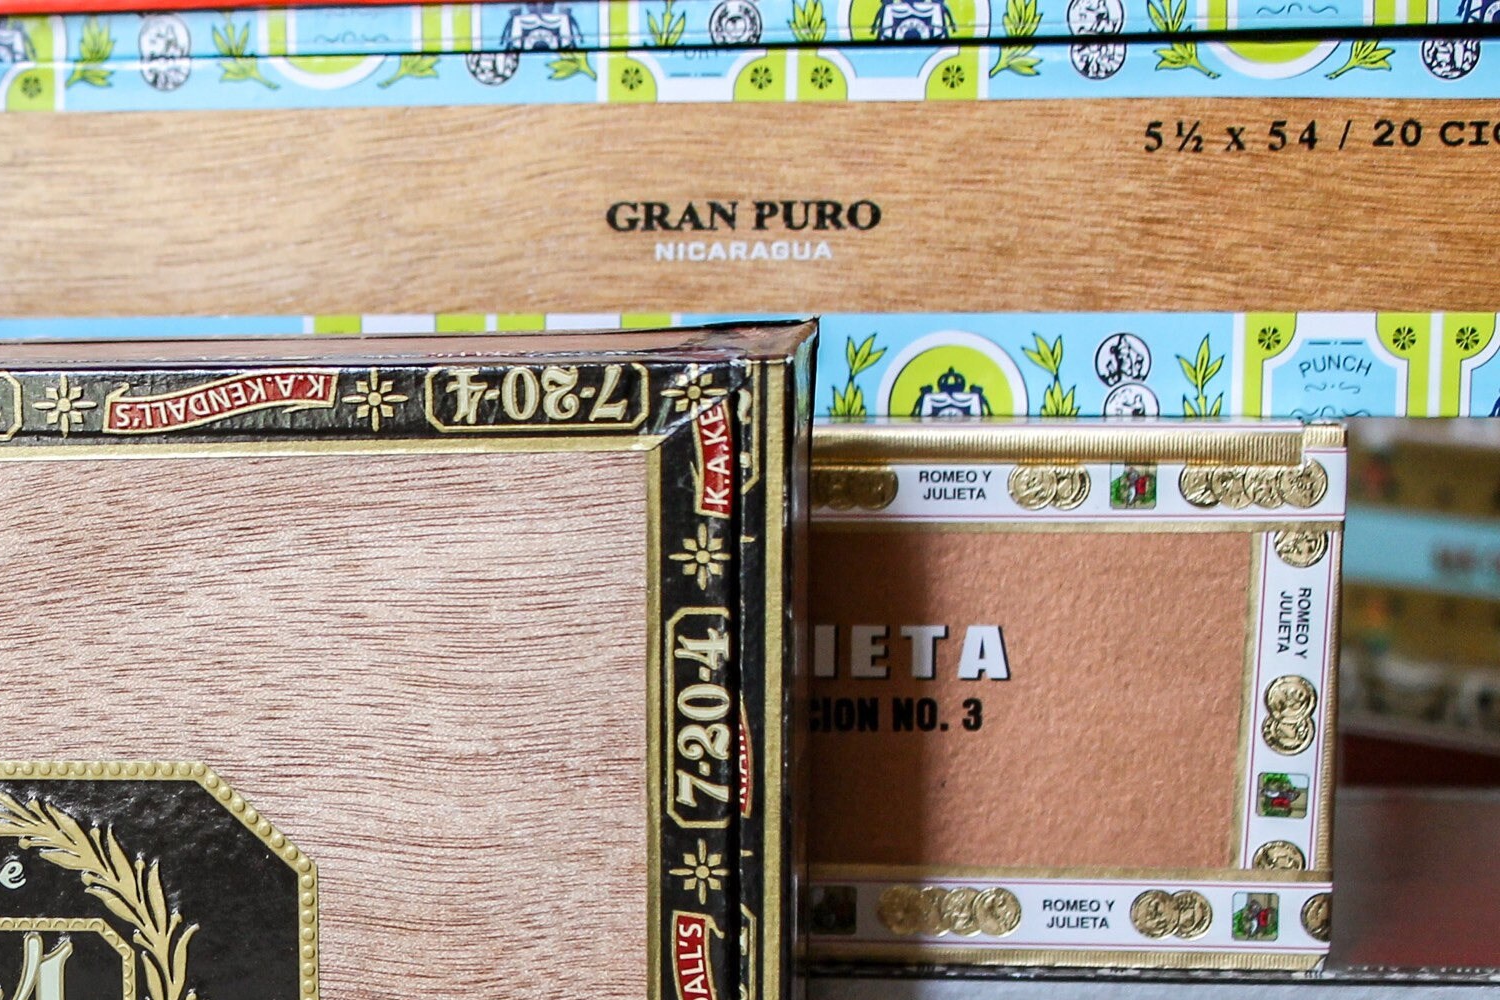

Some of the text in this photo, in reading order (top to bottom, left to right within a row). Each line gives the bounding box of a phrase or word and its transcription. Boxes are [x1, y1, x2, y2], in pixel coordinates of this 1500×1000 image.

[1372, 119, 1423, 148] 20
[1439, 119, 1500, 148] CI
[606, 199, 883, 232] GRAN PURO
[654, 239, 833, 263] NICARAGUA
[1299, 354, 1373, 378] PUNCH
[114, 372, 329, 429] K.A.KENDALL'S
[446, 366, 630, 423] 7-20-4
[919, 470, 992, 485] ROMEO Y
[923, 486, 987, 501] JULIETA
[1277, 590, 1292, 655] JULIETA
[1295, 586, 1312, 660] ROMEO Y
[813, 624, 1011, 681] IETA
[675, 628, 731, 806] 7-20-4
[809, 697, 984, 732] ION NO. 3
[1042, 899, 1115, 914] ROMEO Y
[1046, 915, 1109, 930] JULIETA
